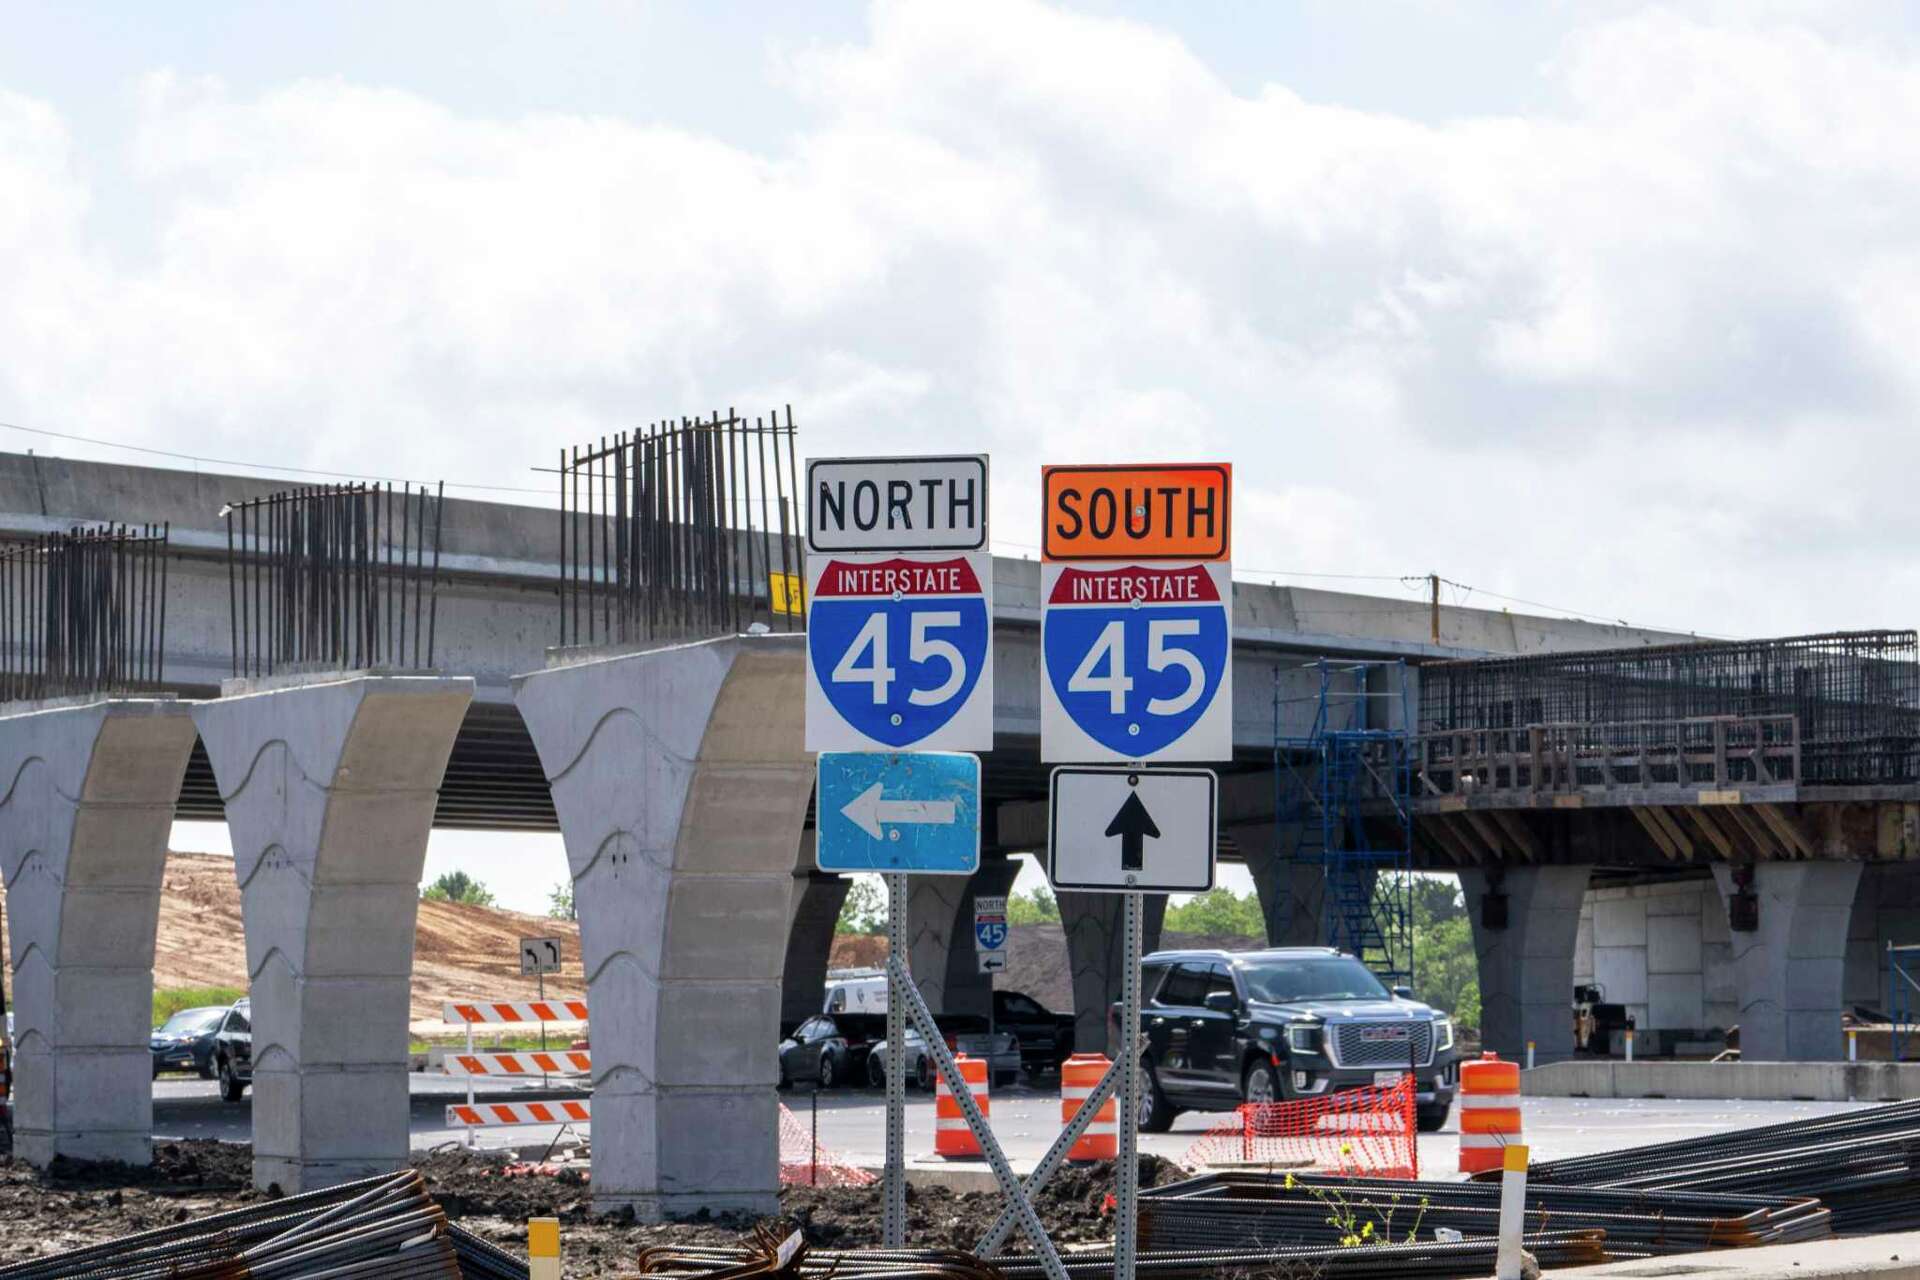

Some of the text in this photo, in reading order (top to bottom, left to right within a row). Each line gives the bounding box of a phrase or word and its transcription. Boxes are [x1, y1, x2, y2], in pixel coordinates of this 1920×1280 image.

[819, 478, 975, 531] NORTH
[1056, 487, 1215, 540] SOUTH
[838, 568, 961, 593] INTERSTATE
[1073, 576, 1199, 600] INTERSTATE
[832, 611, 967, 707] 45
[1067, 619, 1206, 716] 45
[976, 898, 1005, 912] NORTH
[980, 924, 1004, 942] 45
